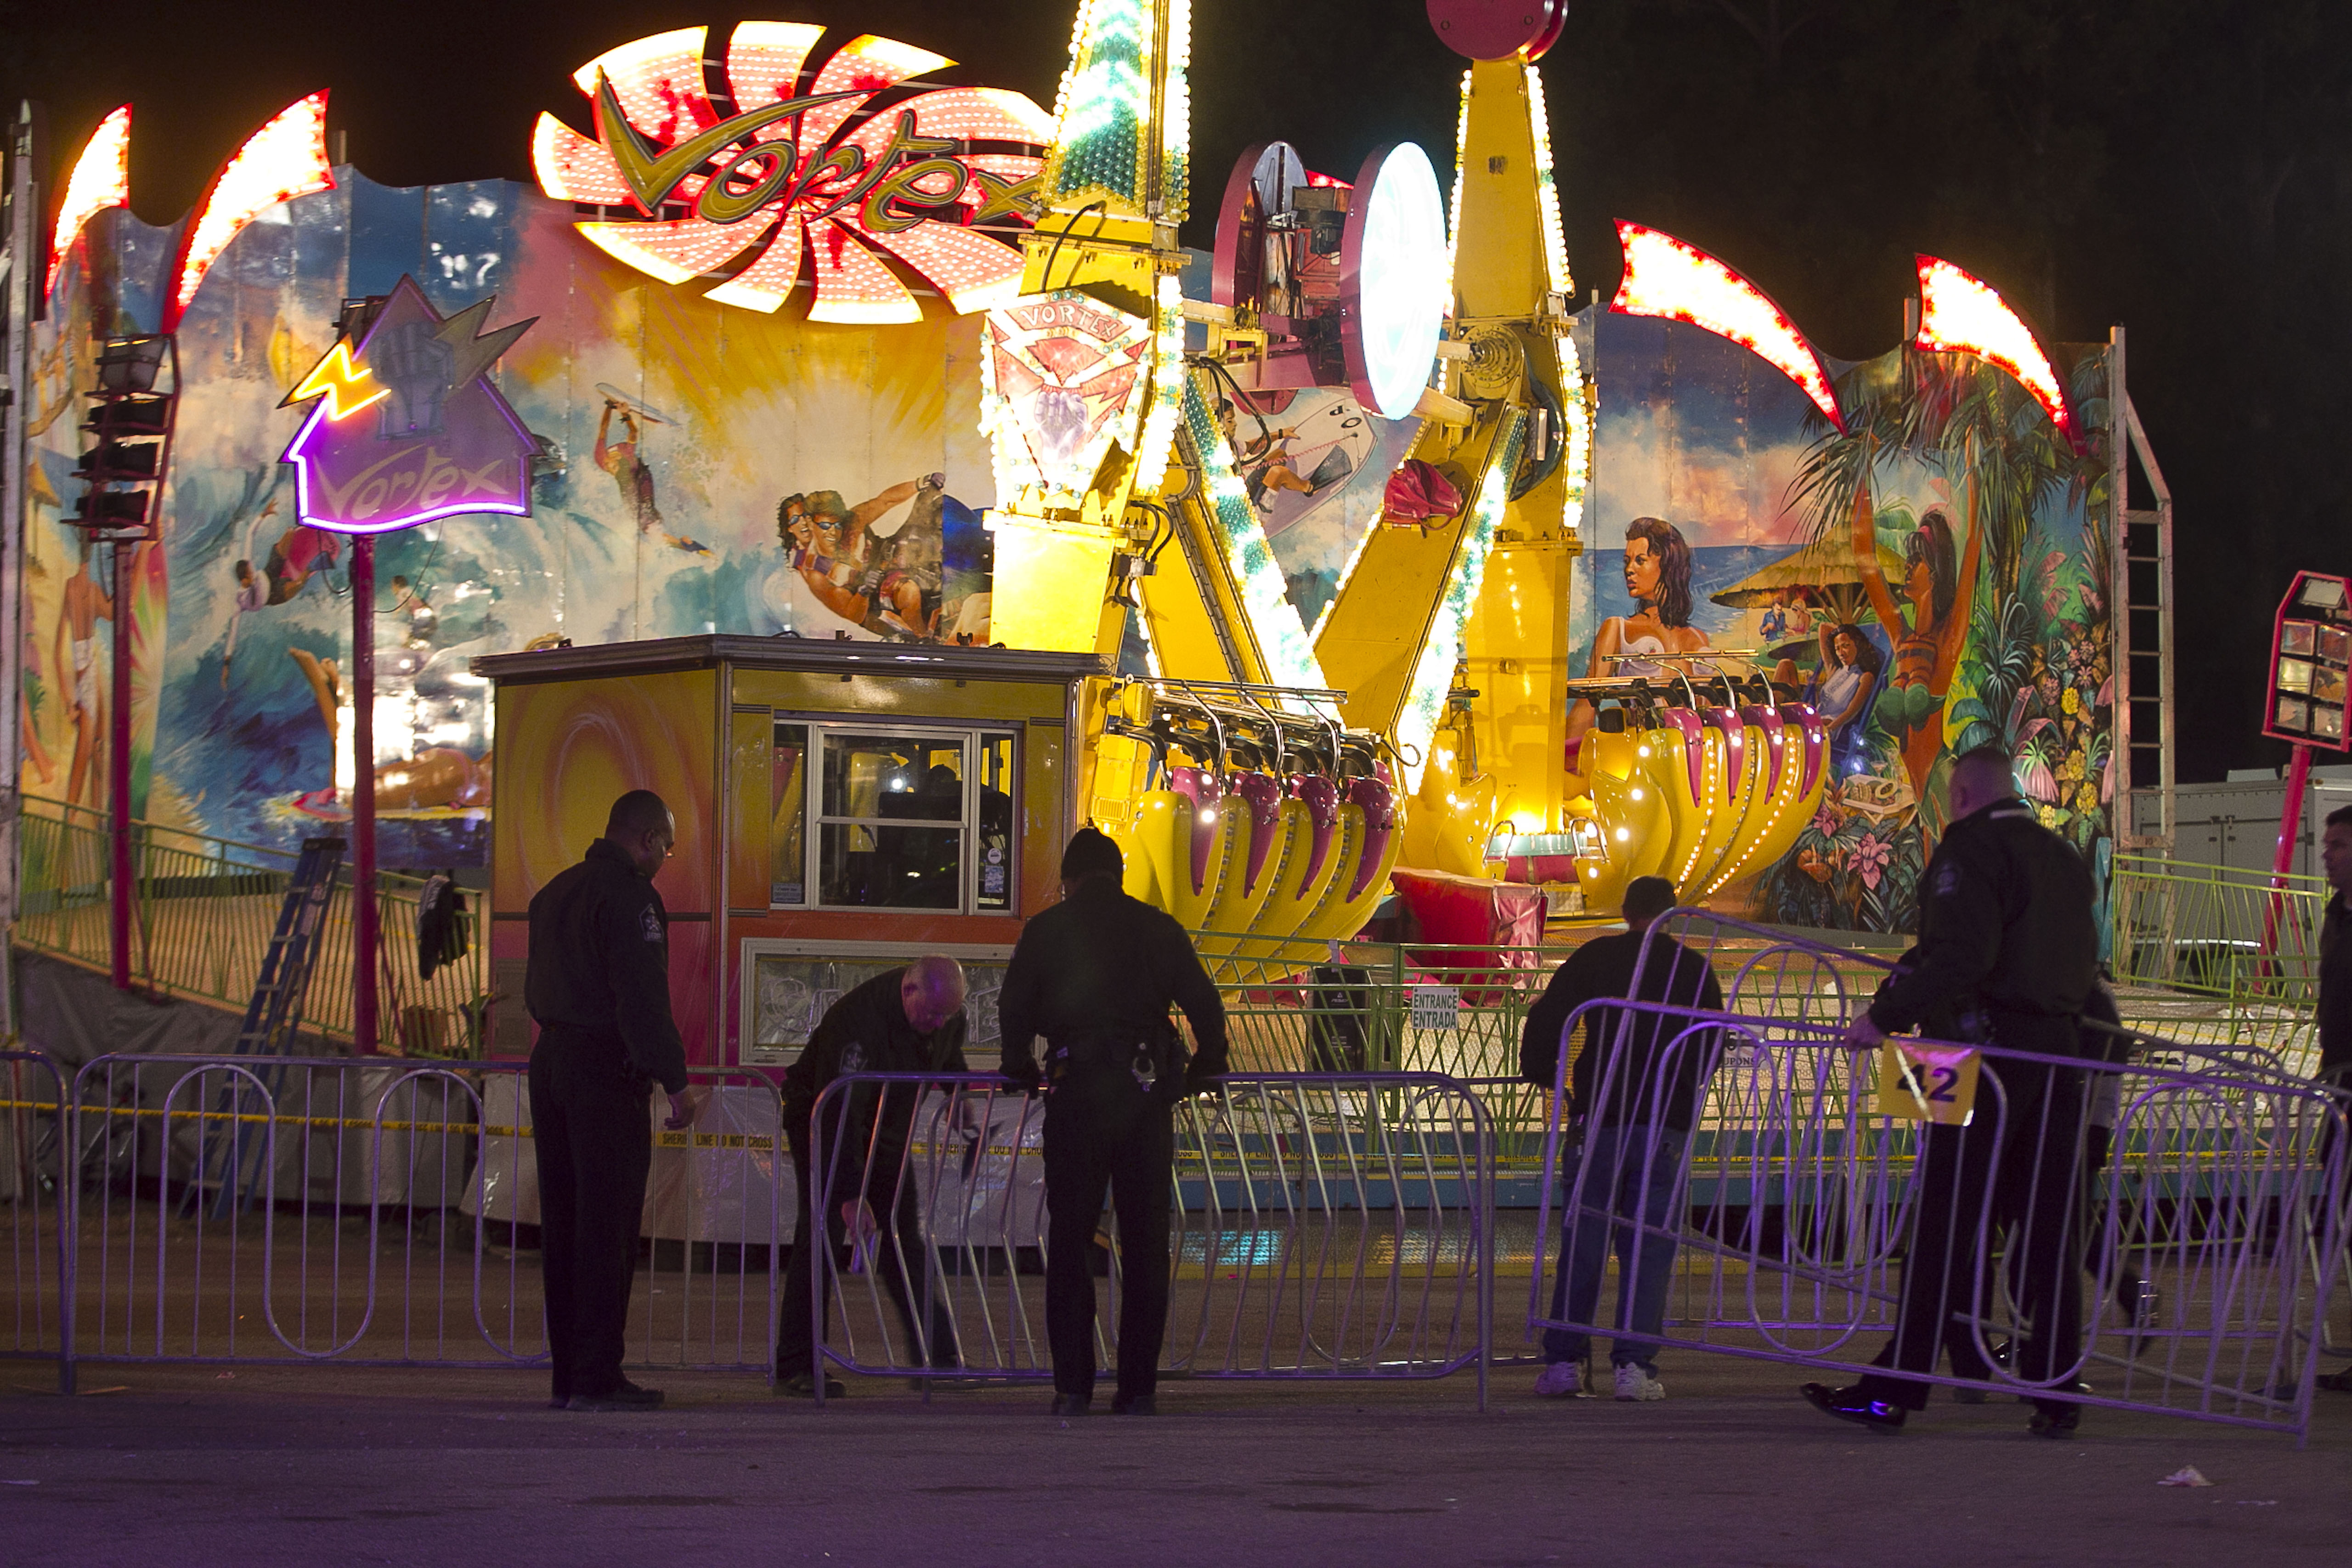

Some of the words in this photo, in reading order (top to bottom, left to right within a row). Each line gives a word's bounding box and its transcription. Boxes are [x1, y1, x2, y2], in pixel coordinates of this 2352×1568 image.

[596, 64, 1046, 233] Vortex
[1018, 304, 1119, 338] VORTEX
[313, 443, 510, 520] Vortex
[1414, 994, 1457, 1009] ENTRANCE
[1413, 1011, 1456, 1028] ENTRADA
[1896, 1064, 1958, 1102] 42
[662, 1133, 687, 1145] SHERI
[696, 1134, 712, 1146] LINE
[748, 1136, 773, 1148] CROSS
